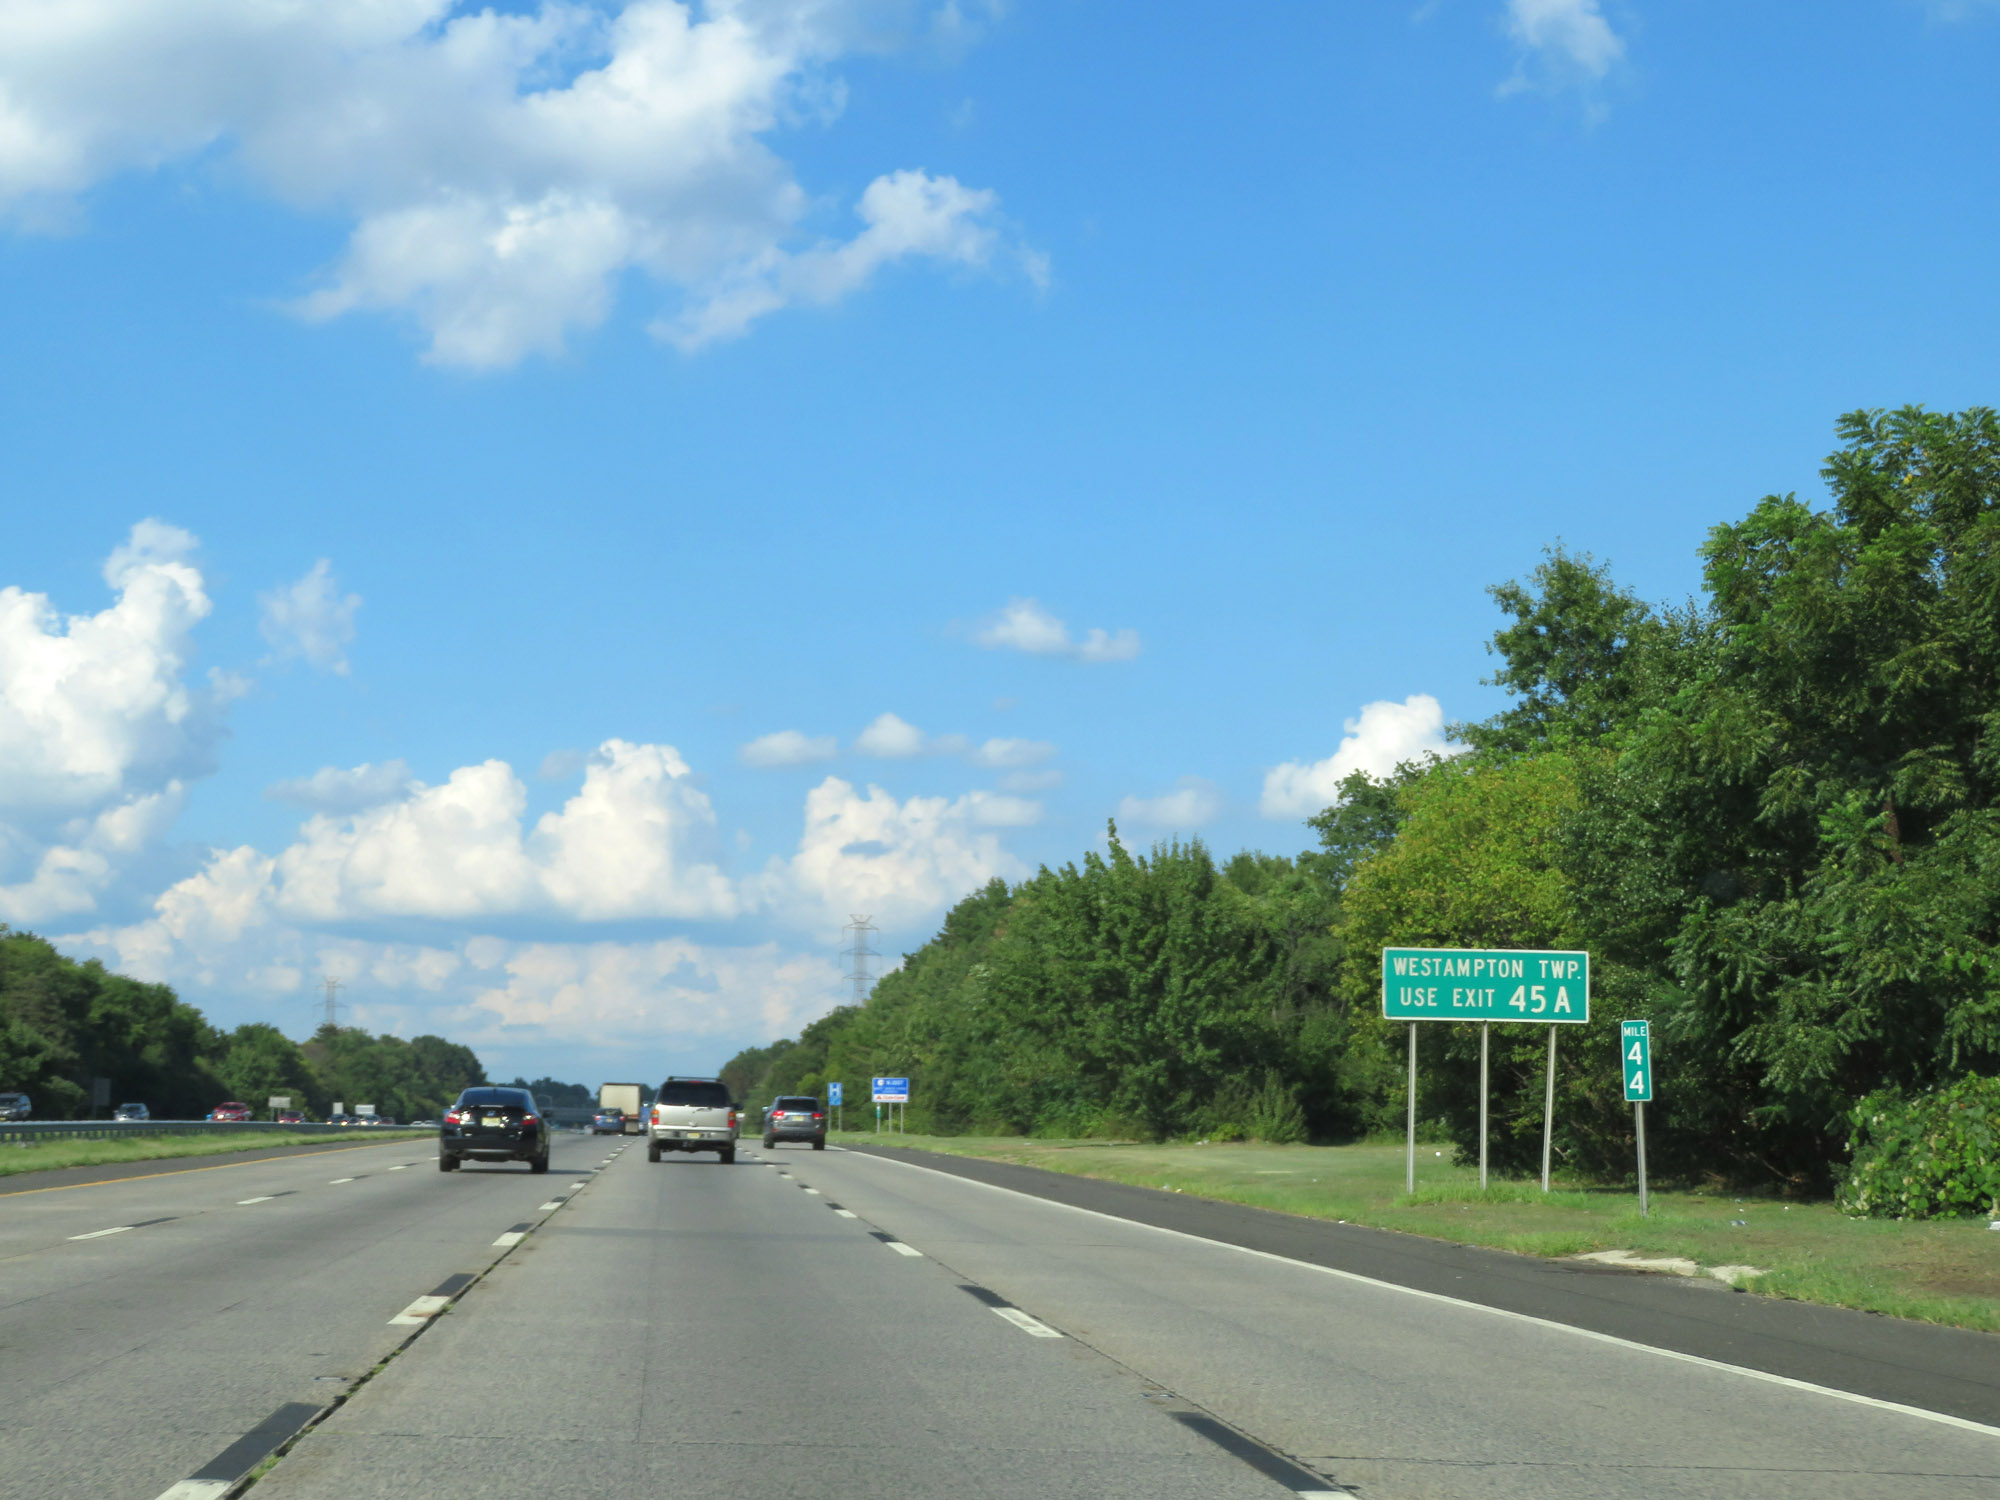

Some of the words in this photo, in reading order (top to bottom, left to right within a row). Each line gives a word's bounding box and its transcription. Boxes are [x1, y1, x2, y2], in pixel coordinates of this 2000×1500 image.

[1393, 958, 1524, 978] WESTAMPTON
[1540, 960, 1582, 979] TWP.
[1400, 987, 1438, 1007] USE
[1453, 988, 1495, 1007] EXIT
[1624, 1026, 1646, 1037] MILE
